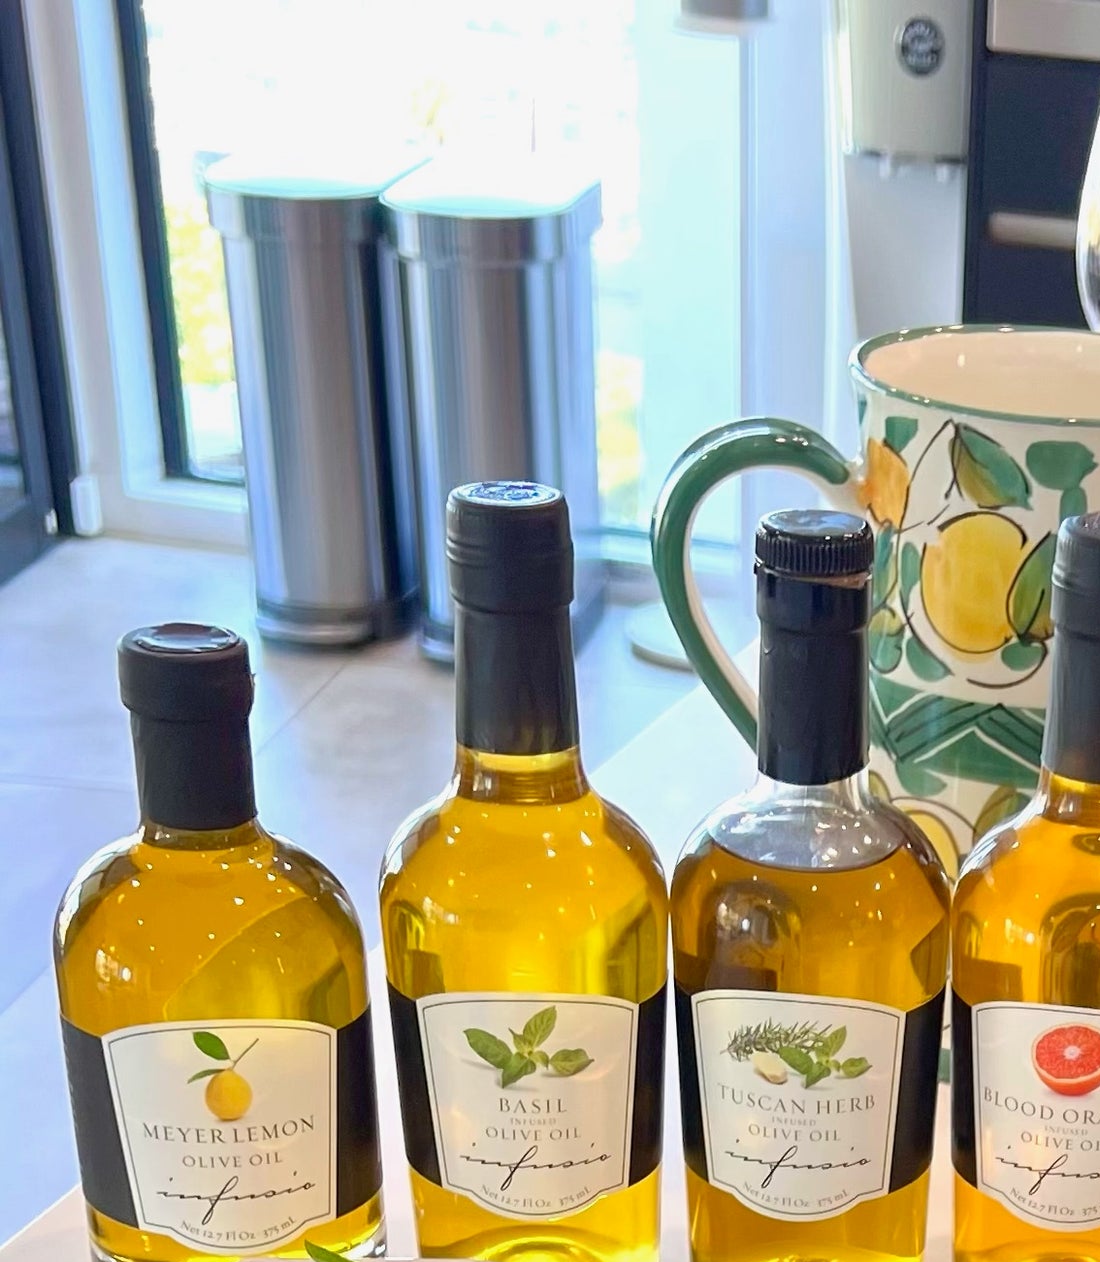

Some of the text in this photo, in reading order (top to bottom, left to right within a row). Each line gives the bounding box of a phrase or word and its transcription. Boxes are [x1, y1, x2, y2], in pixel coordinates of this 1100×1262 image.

[498, 1097, 568, 1114] BASIL
[717, 1082, 876, 1115] TUSCAN HERB
[984, 1086, 1054, 1121] BLOOD
[142, 1114, 316, 1144] MEYER LEMON
[485, 1127, 581, 1142] OLIVE OIL
[748, 1123, 841, 1142] OLIVE OIL
[1020, 1131, 1073, 1151] OLIVE
[182, 1152, 283, 1168] OLIVE OIL
[481, 1184, 498, 1199] Net
[1010, 1187, 1026, 1204] Net
[1082, 1206, 1098, 1216] 375
[181, 1220, 200, 1235] Net
[226, 1231, 236, 1241] Fl
[239, 1231, 256, 1240] Oz
[263, 1226, 280, 1238] 375
